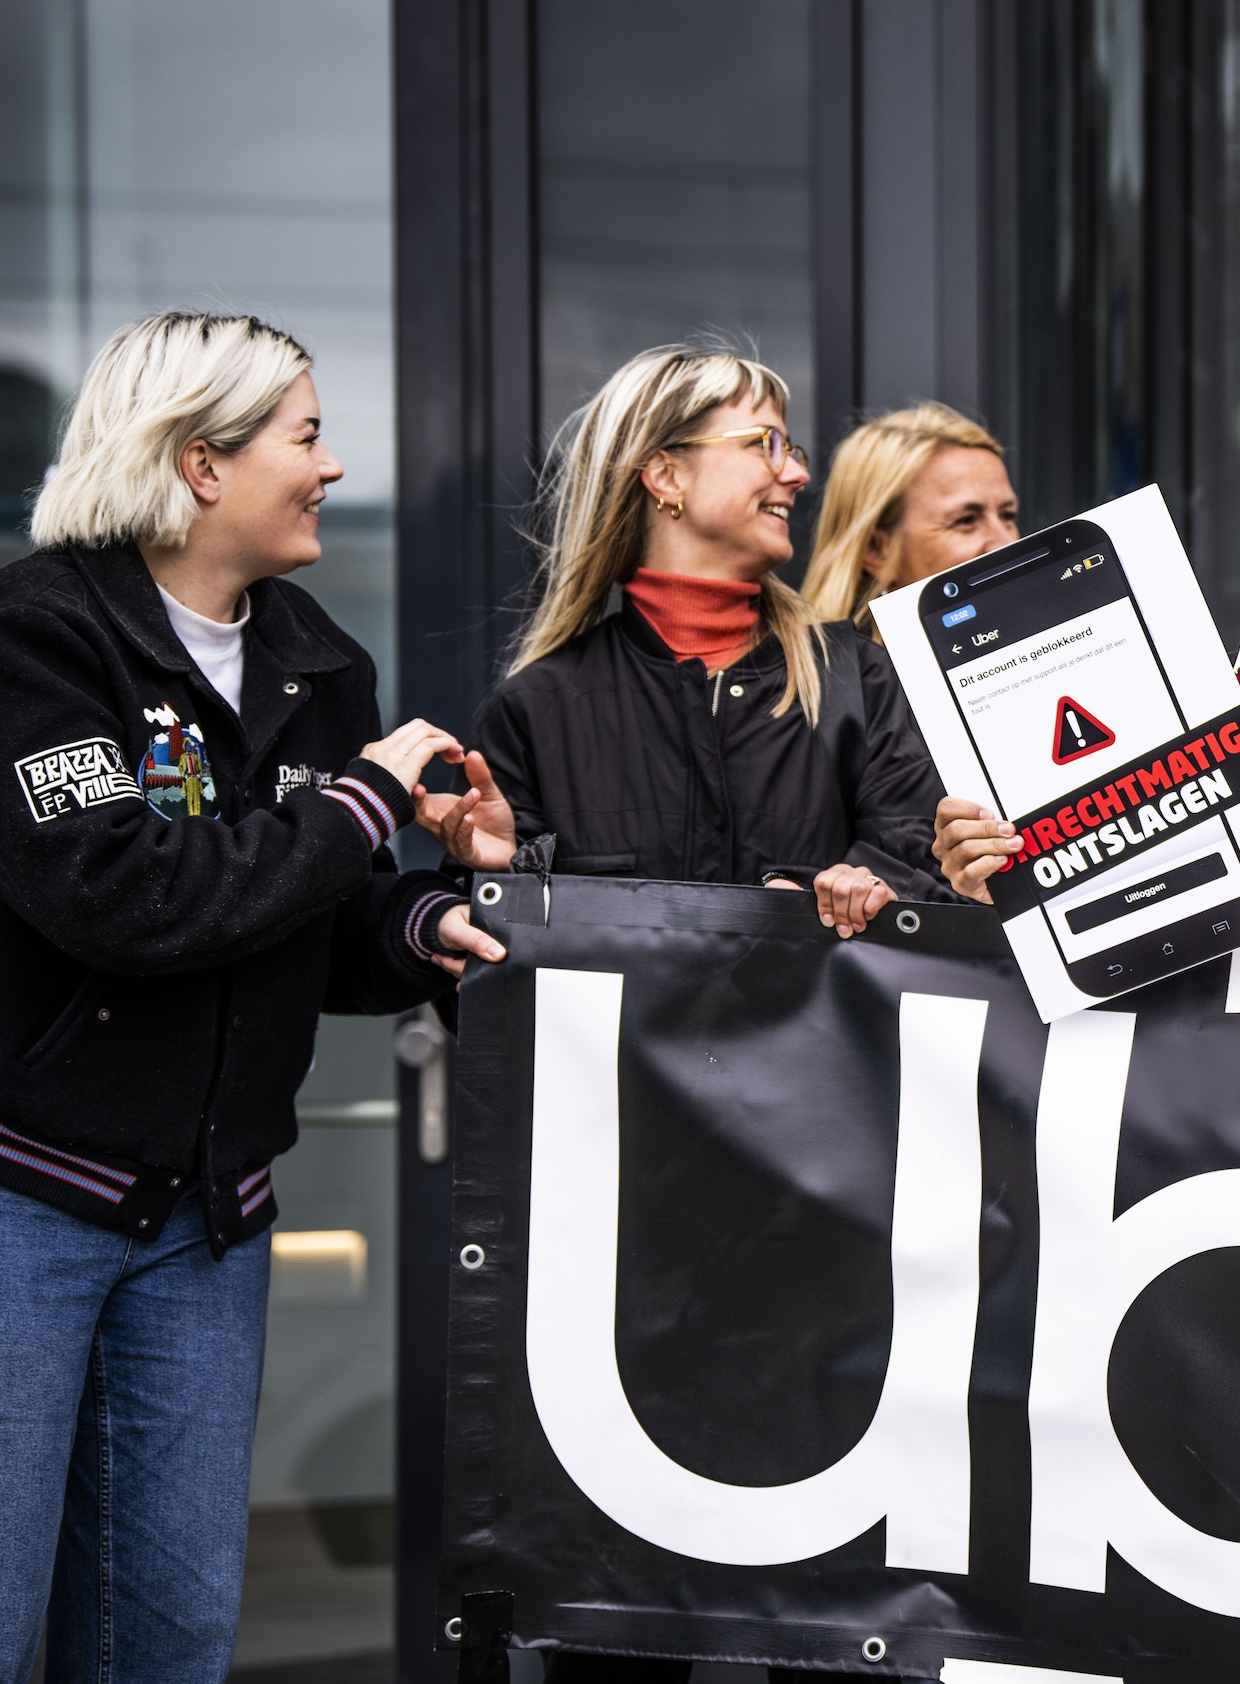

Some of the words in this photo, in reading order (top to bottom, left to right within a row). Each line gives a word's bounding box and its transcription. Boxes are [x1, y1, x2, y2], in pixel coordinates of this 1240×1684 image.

[949, 609, 969, 623] 12:02
[971, 629, 999, 647] Uber
[959, 675, 975, 688] Dit
[976, 658, 1017, 681] account
[1018, 655, 1028, 664] is
[1029, 626, 1093, 661] geblokkeerd
[24, 743, 116, 794] BRAZZA
[278, 763, 310, 786] Daily
[1032, 768, 1233, 889] ONTSLAGEN
[1124, 882, 1167, 904] Uitloggen
